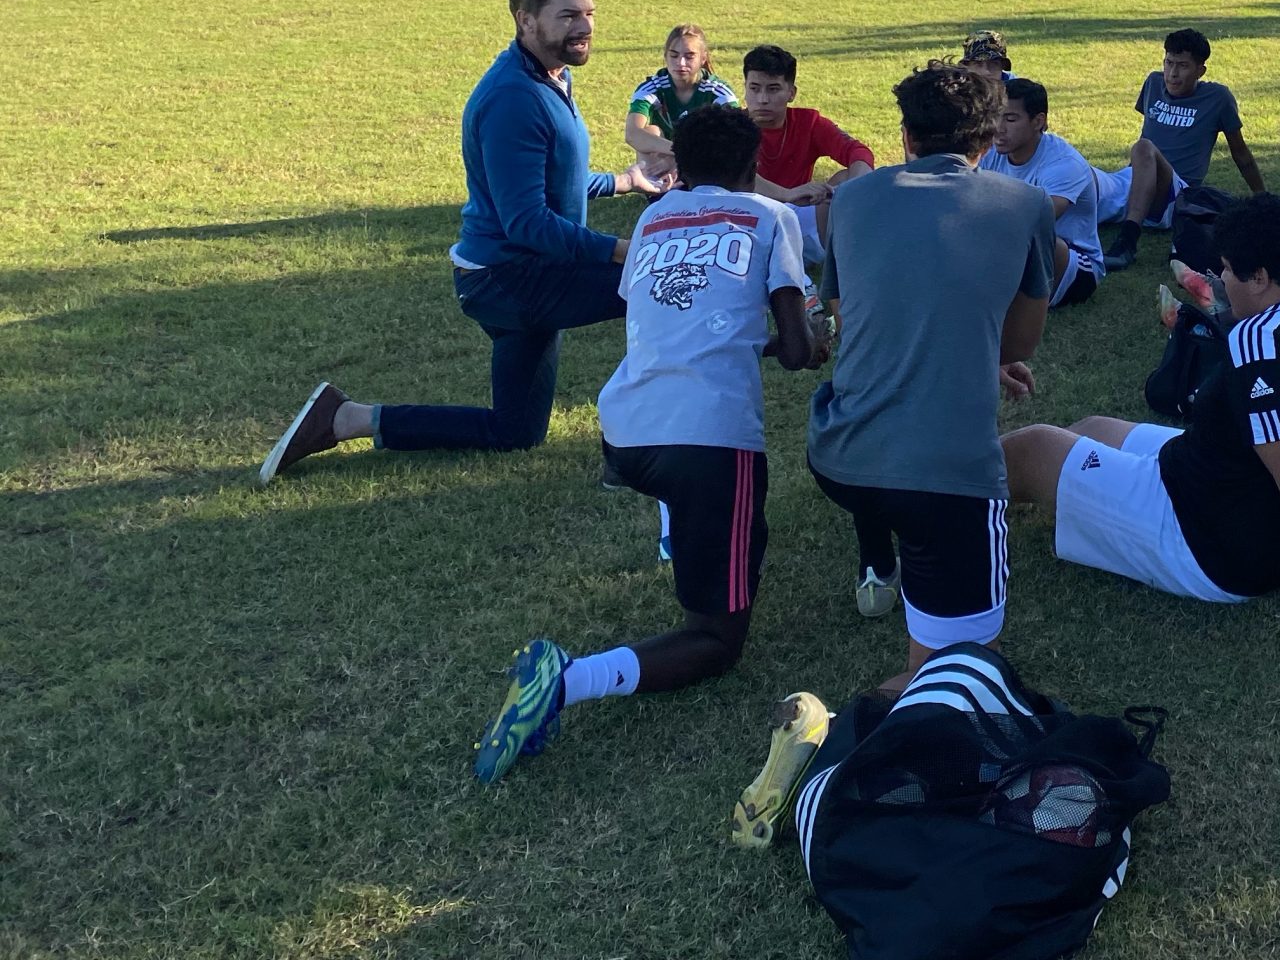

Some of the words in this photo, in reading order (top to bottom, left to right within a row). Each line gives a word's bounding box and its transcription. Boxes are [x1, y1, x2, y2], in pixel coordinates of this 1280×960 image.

[1170, 105, 1198, 117] VALLEY
[1157, 111, 1195, 127] UNITED
[630, 231, 753, 288] 2020
[1250, 387, 1275, 399] adidas
